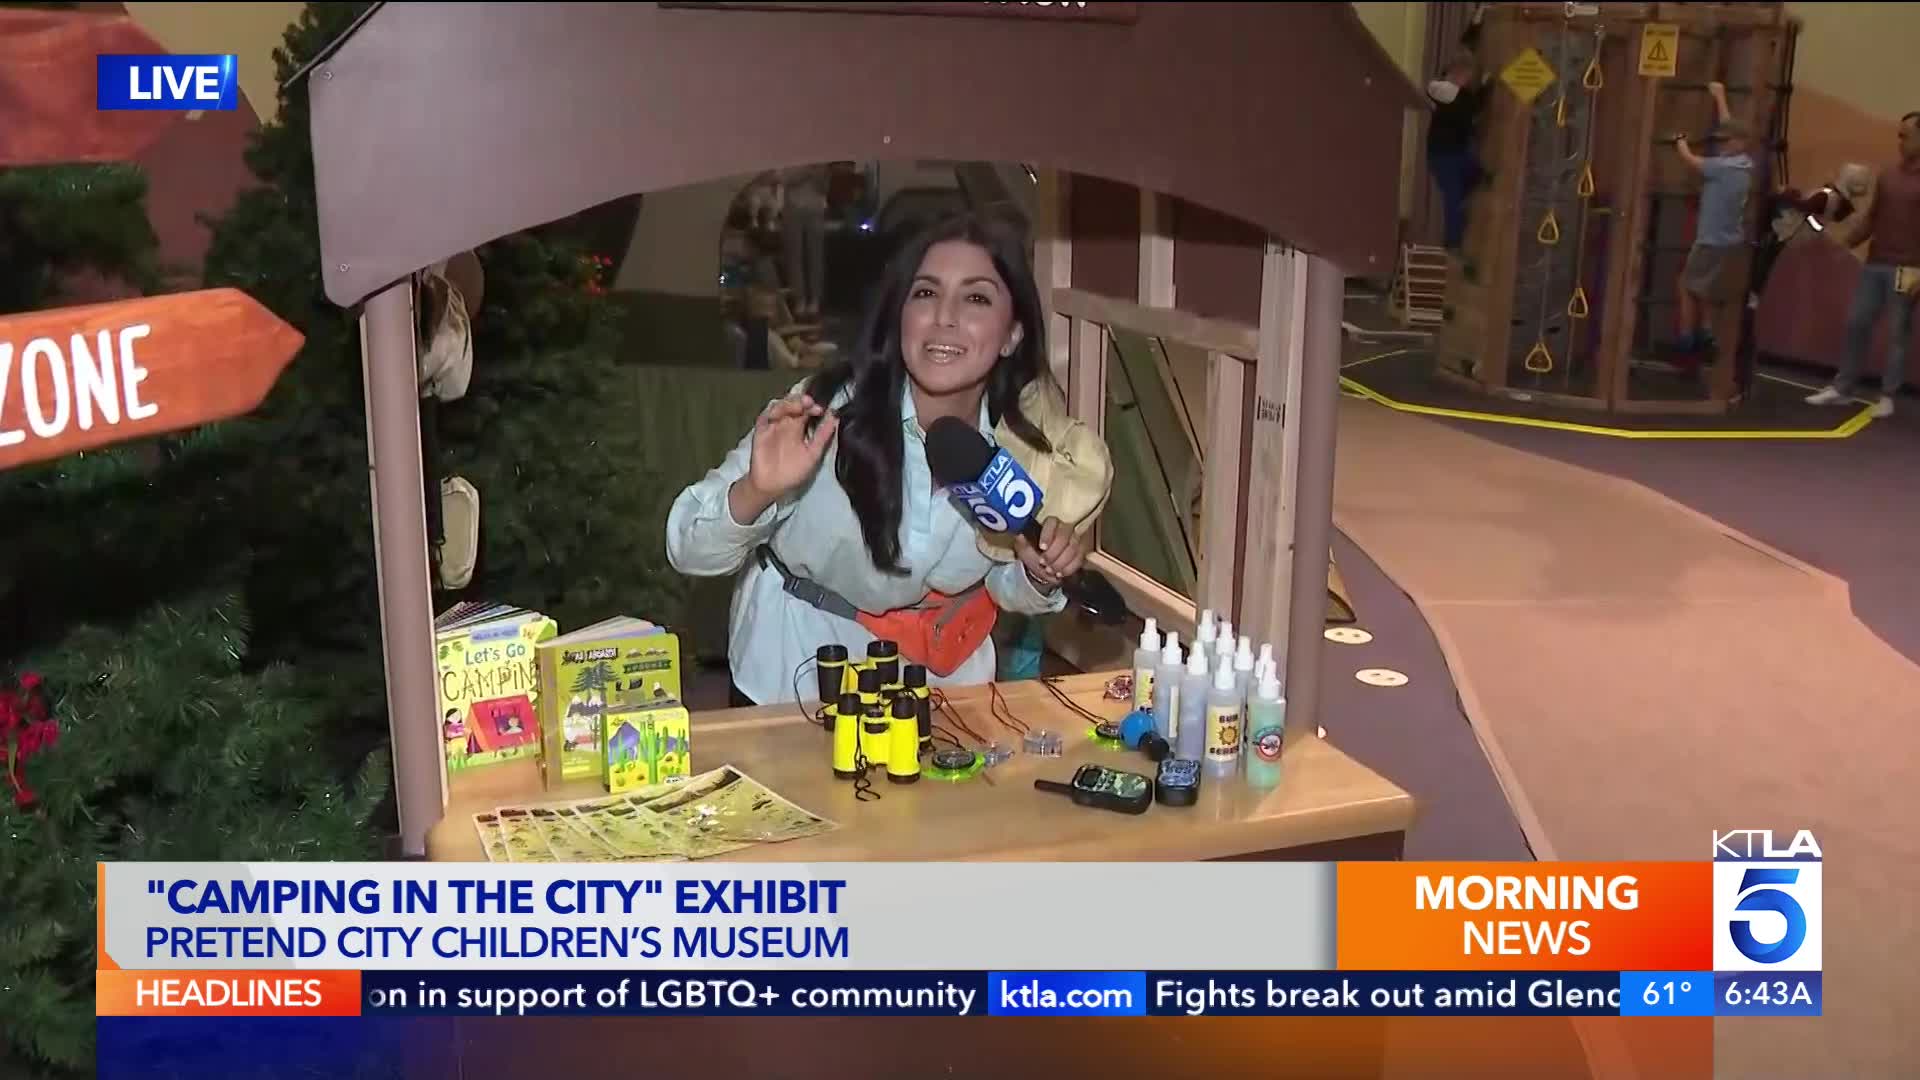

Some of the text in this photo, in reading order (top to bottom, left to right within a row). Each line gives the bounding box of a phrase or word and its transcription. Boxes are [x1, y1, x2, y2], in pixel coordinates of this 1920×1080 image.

[0, 324, 159, 447] ZONE
[980, 455, 1010, 490] KTLA
[996, 468, 1035, 518] 5
[465, 642, 526, 666] Let's Go
